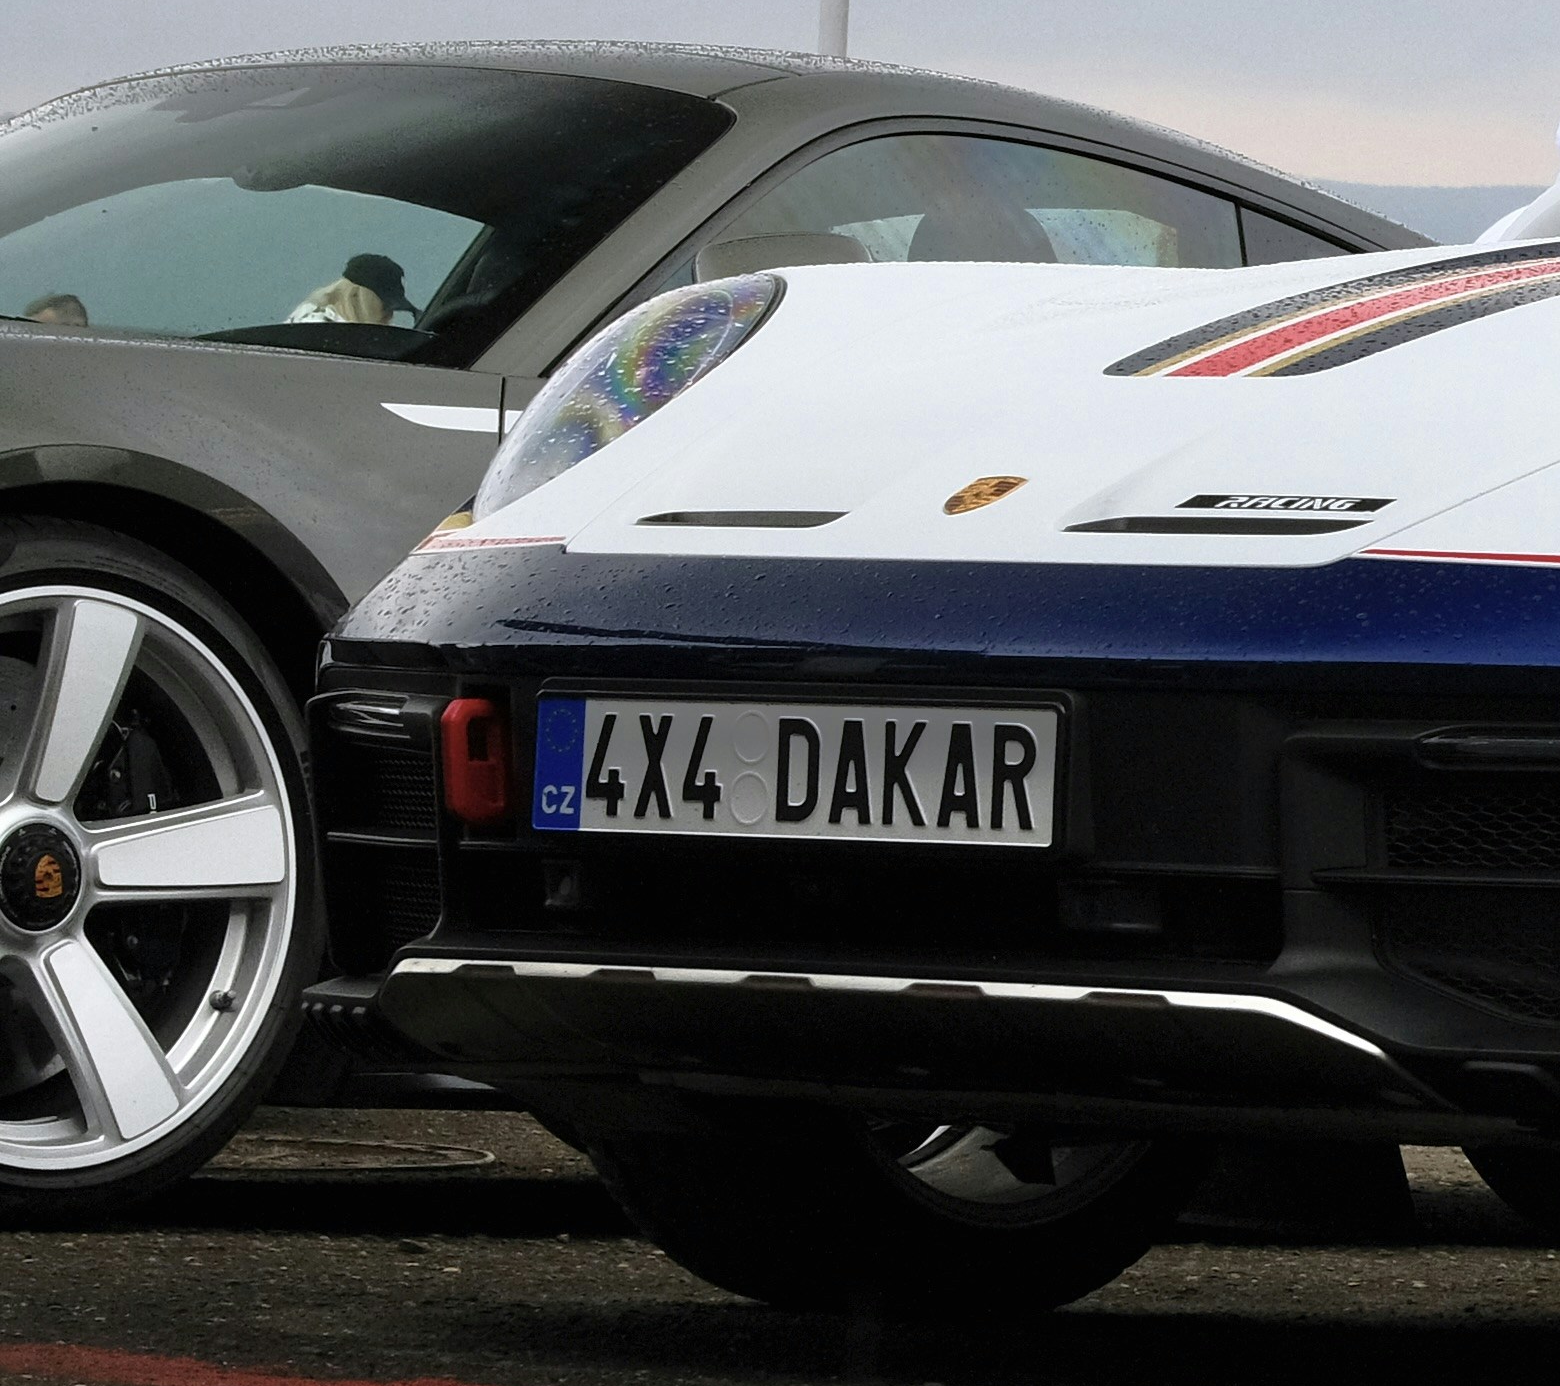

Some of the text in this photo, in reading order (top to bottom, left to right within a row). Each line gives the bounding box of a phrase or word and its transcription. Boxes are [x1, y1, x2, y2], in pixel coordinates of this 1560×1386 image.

[1214, 496, 1363, 511] RACING
[585, 713, 1036, 830] 4X4 DAKAR
[541, 784, 575, 816] CZ
